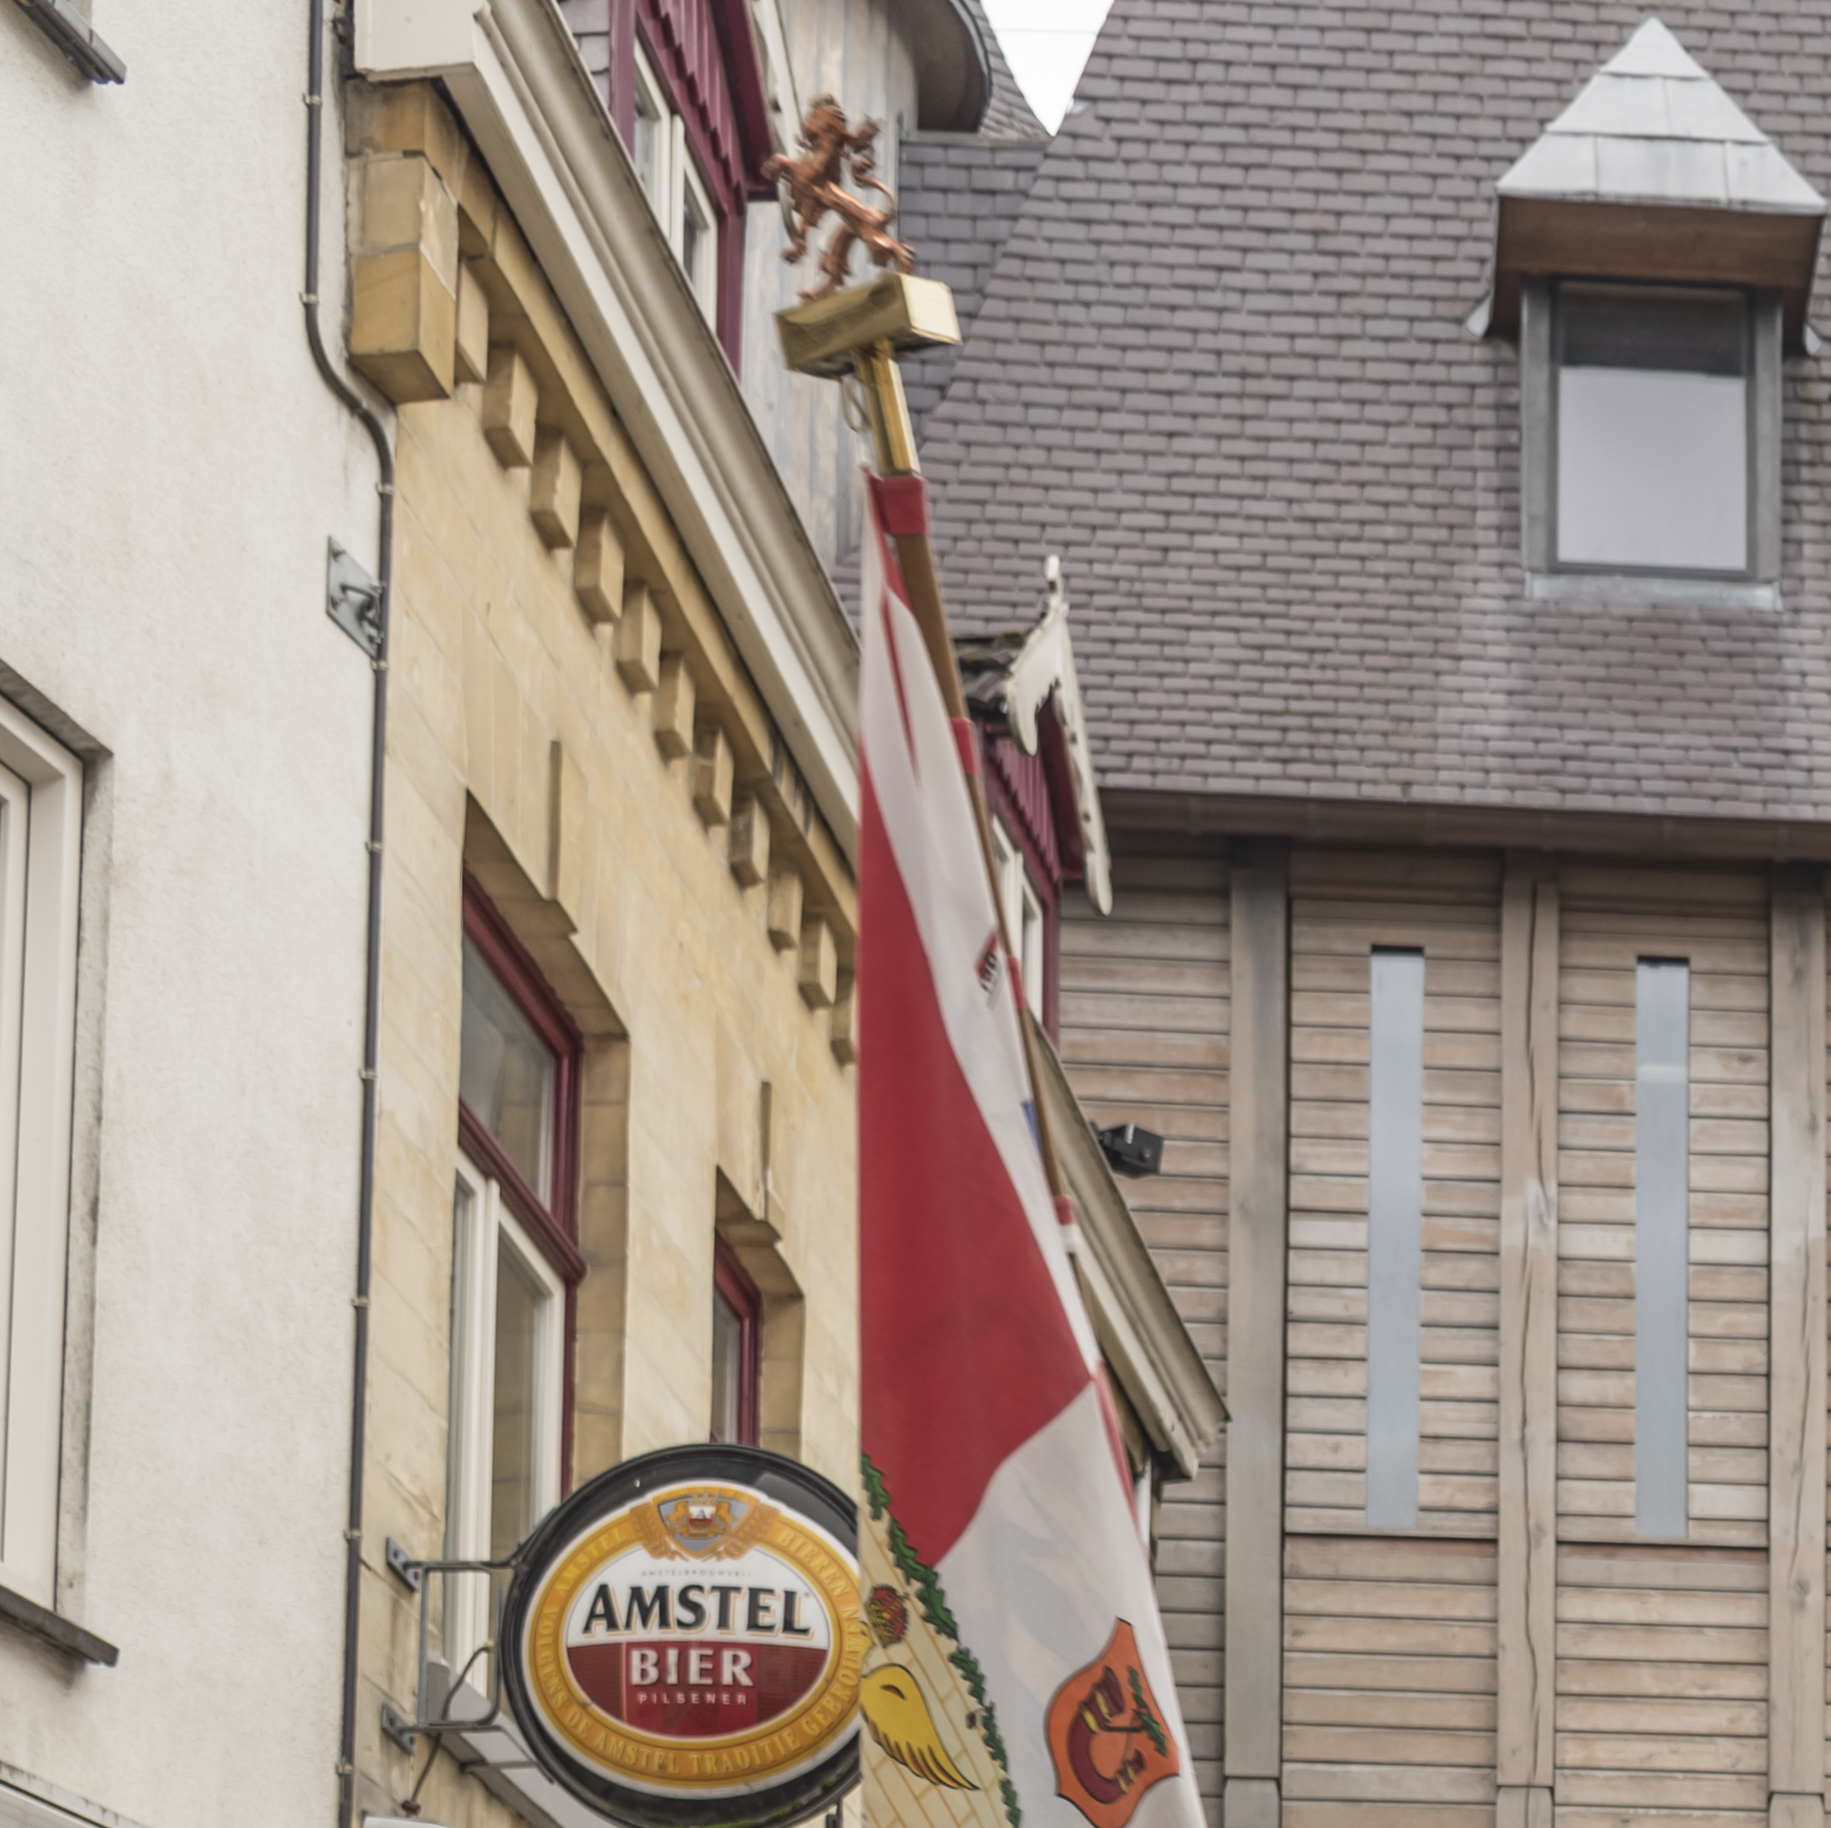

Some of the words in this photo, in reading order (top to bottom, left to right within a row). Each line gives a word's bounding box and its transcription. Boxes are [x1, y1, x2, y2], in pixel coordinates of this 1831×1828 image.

[582, 1583, 814, 1640] AMSTEL
[630, 1647, 754, 1687] BIER
[638, 1692, 748, 1706] PILSENER
[566, 1709, 593, 1739] DE
[594, 1730, 680, 1774] AMSTEL
[688, 1729, 800, 1775] TRADITIE
